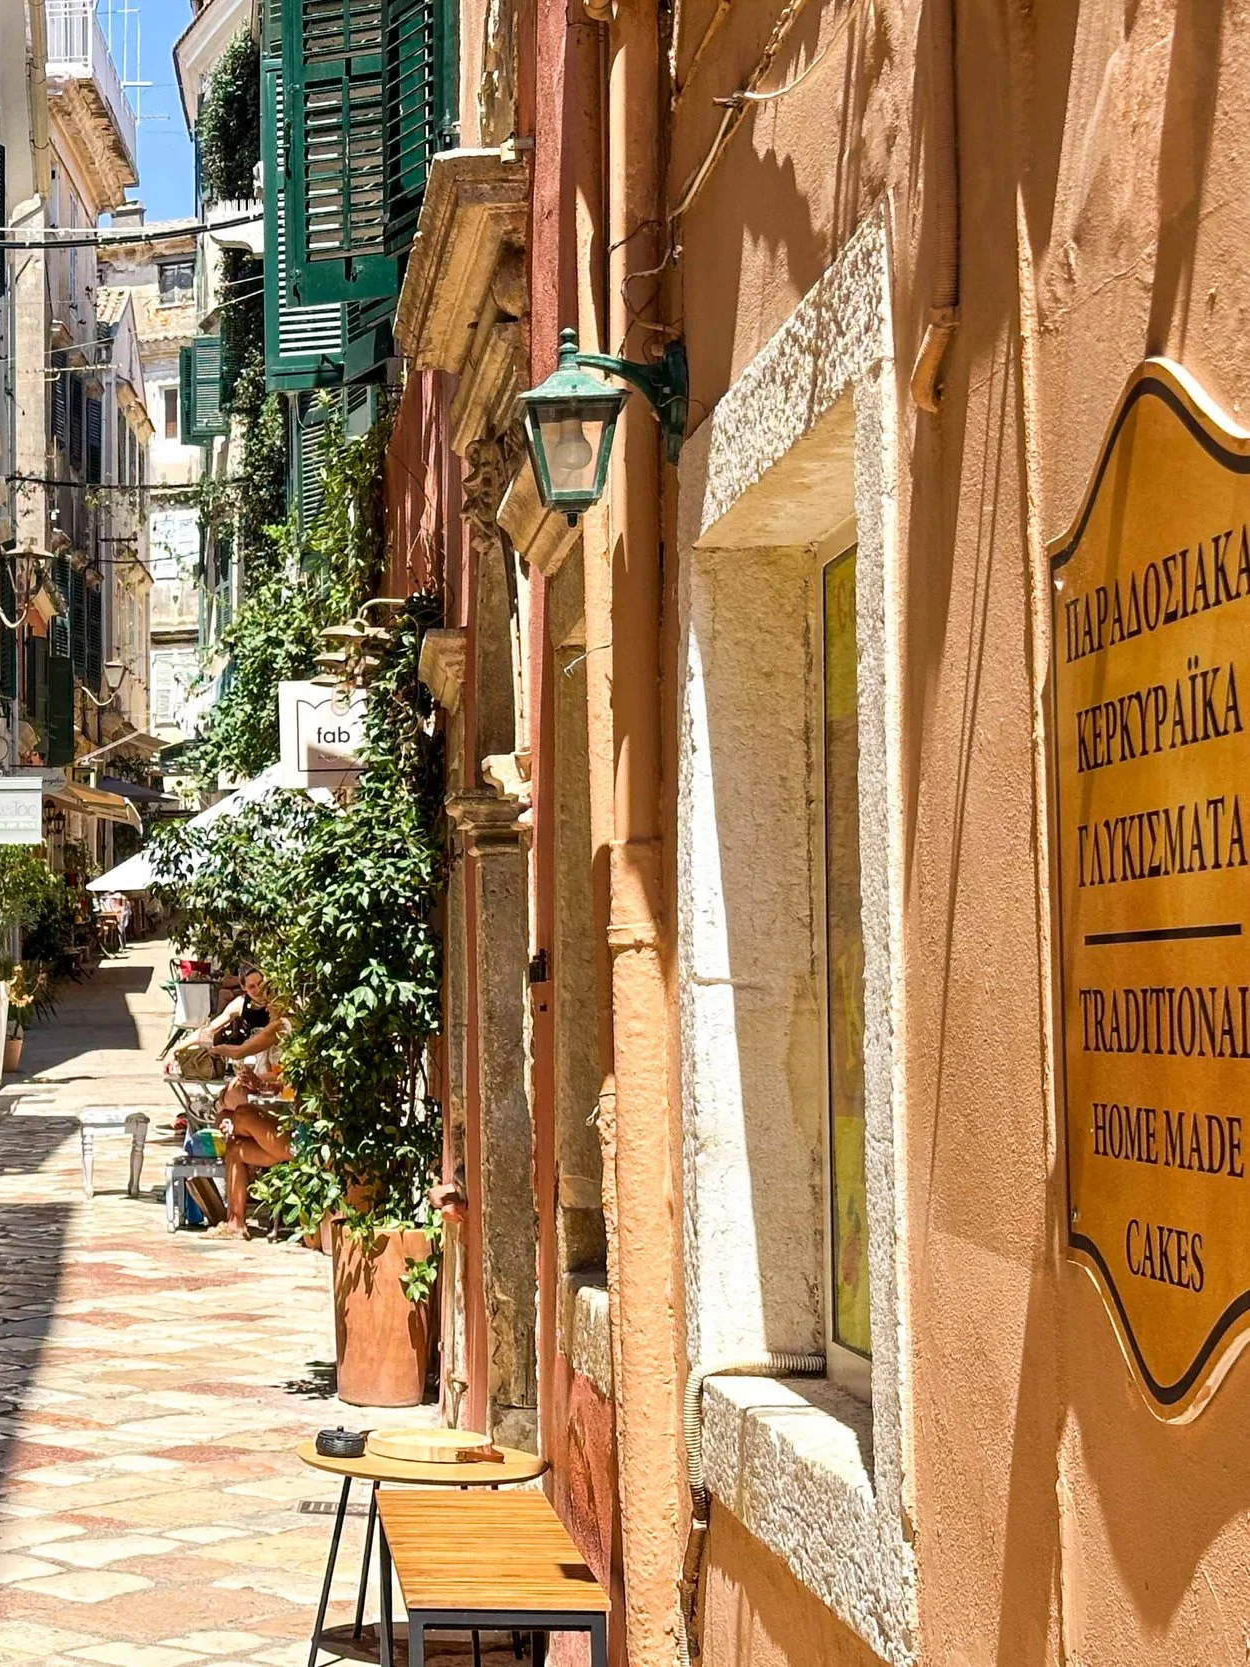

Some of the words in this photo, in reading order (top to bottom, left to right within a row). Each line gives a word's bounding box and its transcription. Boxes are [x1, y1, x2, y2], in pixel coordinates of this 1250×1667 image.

[317, 726, 351, 744] fab
[1075, 655, 1244, 775] ΚΕΡΚΥΡΑΪΚΑ
[1077, 794, 1249, 887] ΓΛΥΚΙΣΜΑΤΑ
[1092, 1102, 1158, 1165] HOME
[1163, 1109, 1246, 1180] MADE
[1126, 1218, 1206, 1294] CAKES
